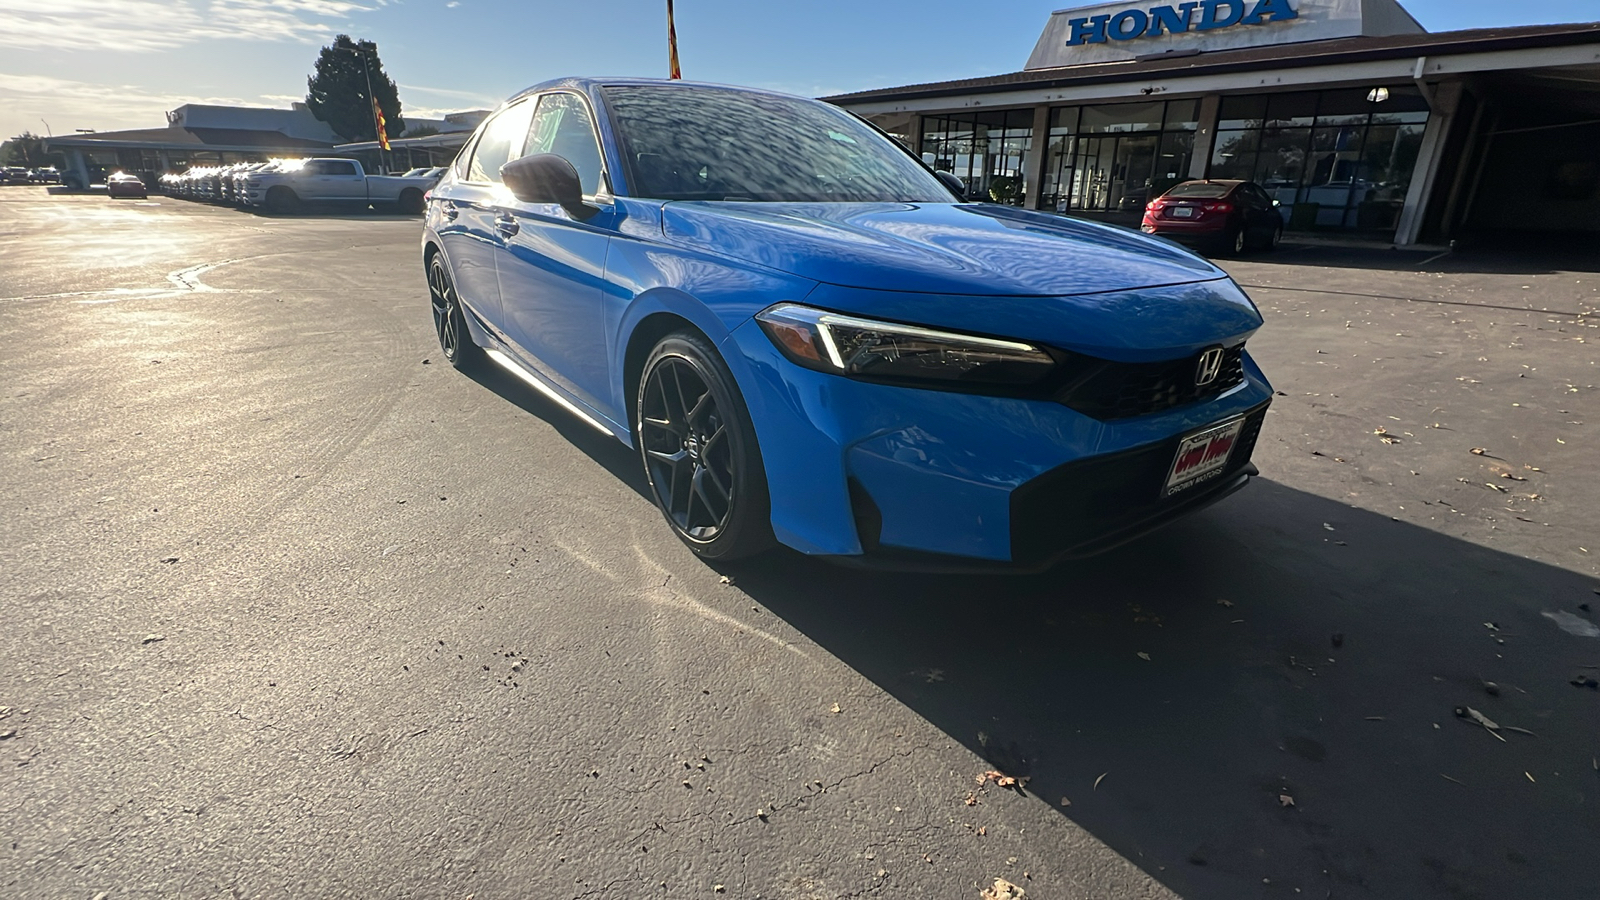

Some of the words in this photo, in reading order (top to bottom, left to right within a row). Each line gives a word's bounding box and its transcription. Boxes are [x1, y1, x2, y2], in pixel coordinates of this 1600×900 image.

[1066, 0, 1298, 46] HONDA
[1167, 479, 1195, 496] CROWN
[1195, 467, 1223, 485] MOTORS
